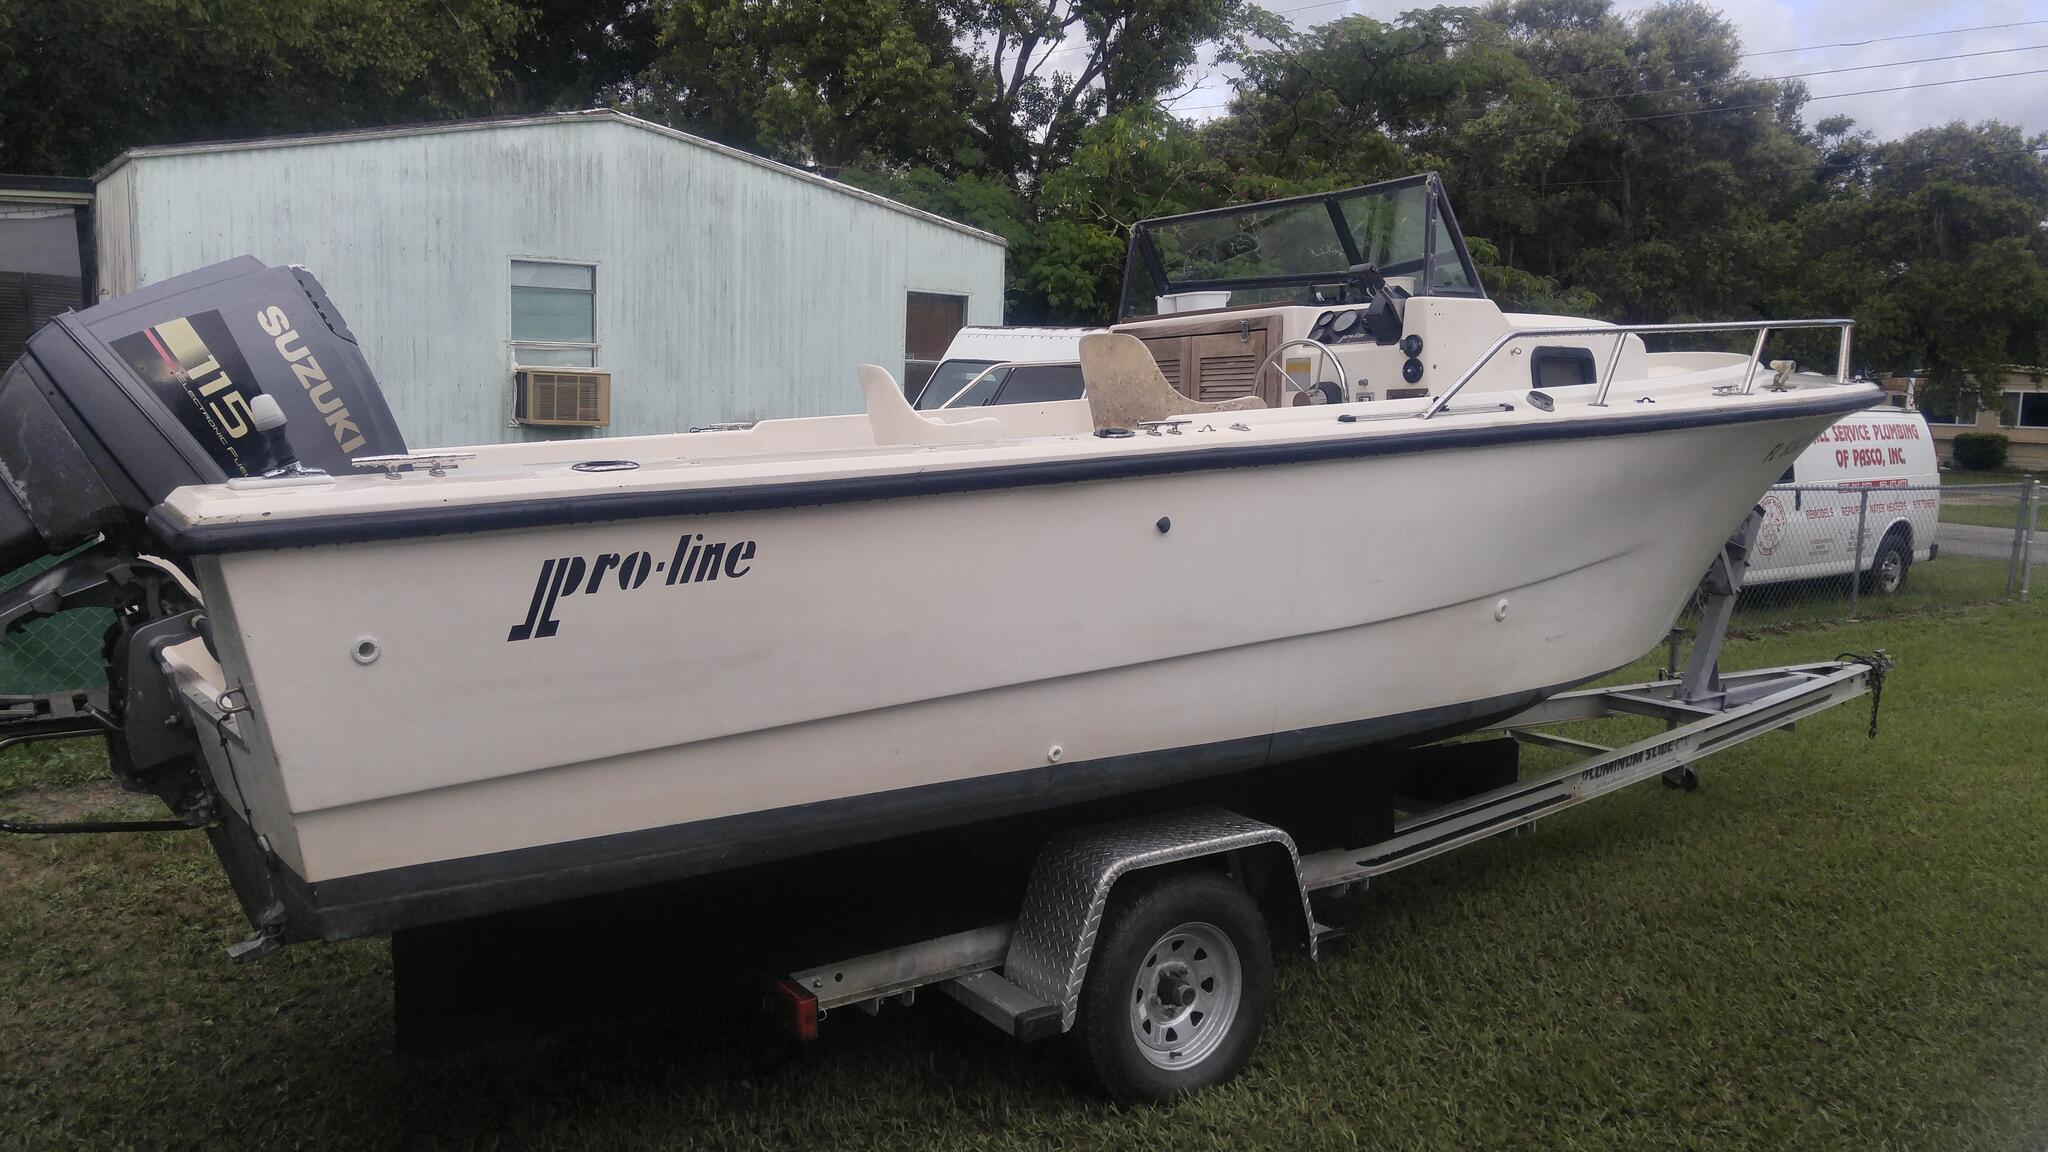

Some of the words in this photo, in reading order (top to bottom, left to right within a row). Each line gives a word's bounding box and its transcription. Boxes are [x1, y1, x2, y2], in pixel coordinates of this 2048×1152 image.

[175, 371, 228, 446] ELECTRONIC
[187, 354, 256, 439] 115
[257, 305, 366, 454] SUZUKI
[1832, 424, 1870, 442] SERVICE
[1872, 424, 1919, 441] PLUMBING
[1835, 449, 1849, 469] OF
[1852, 447, 1885, 468] PASCO,
[1887, 447, 1906, 465] INC.
